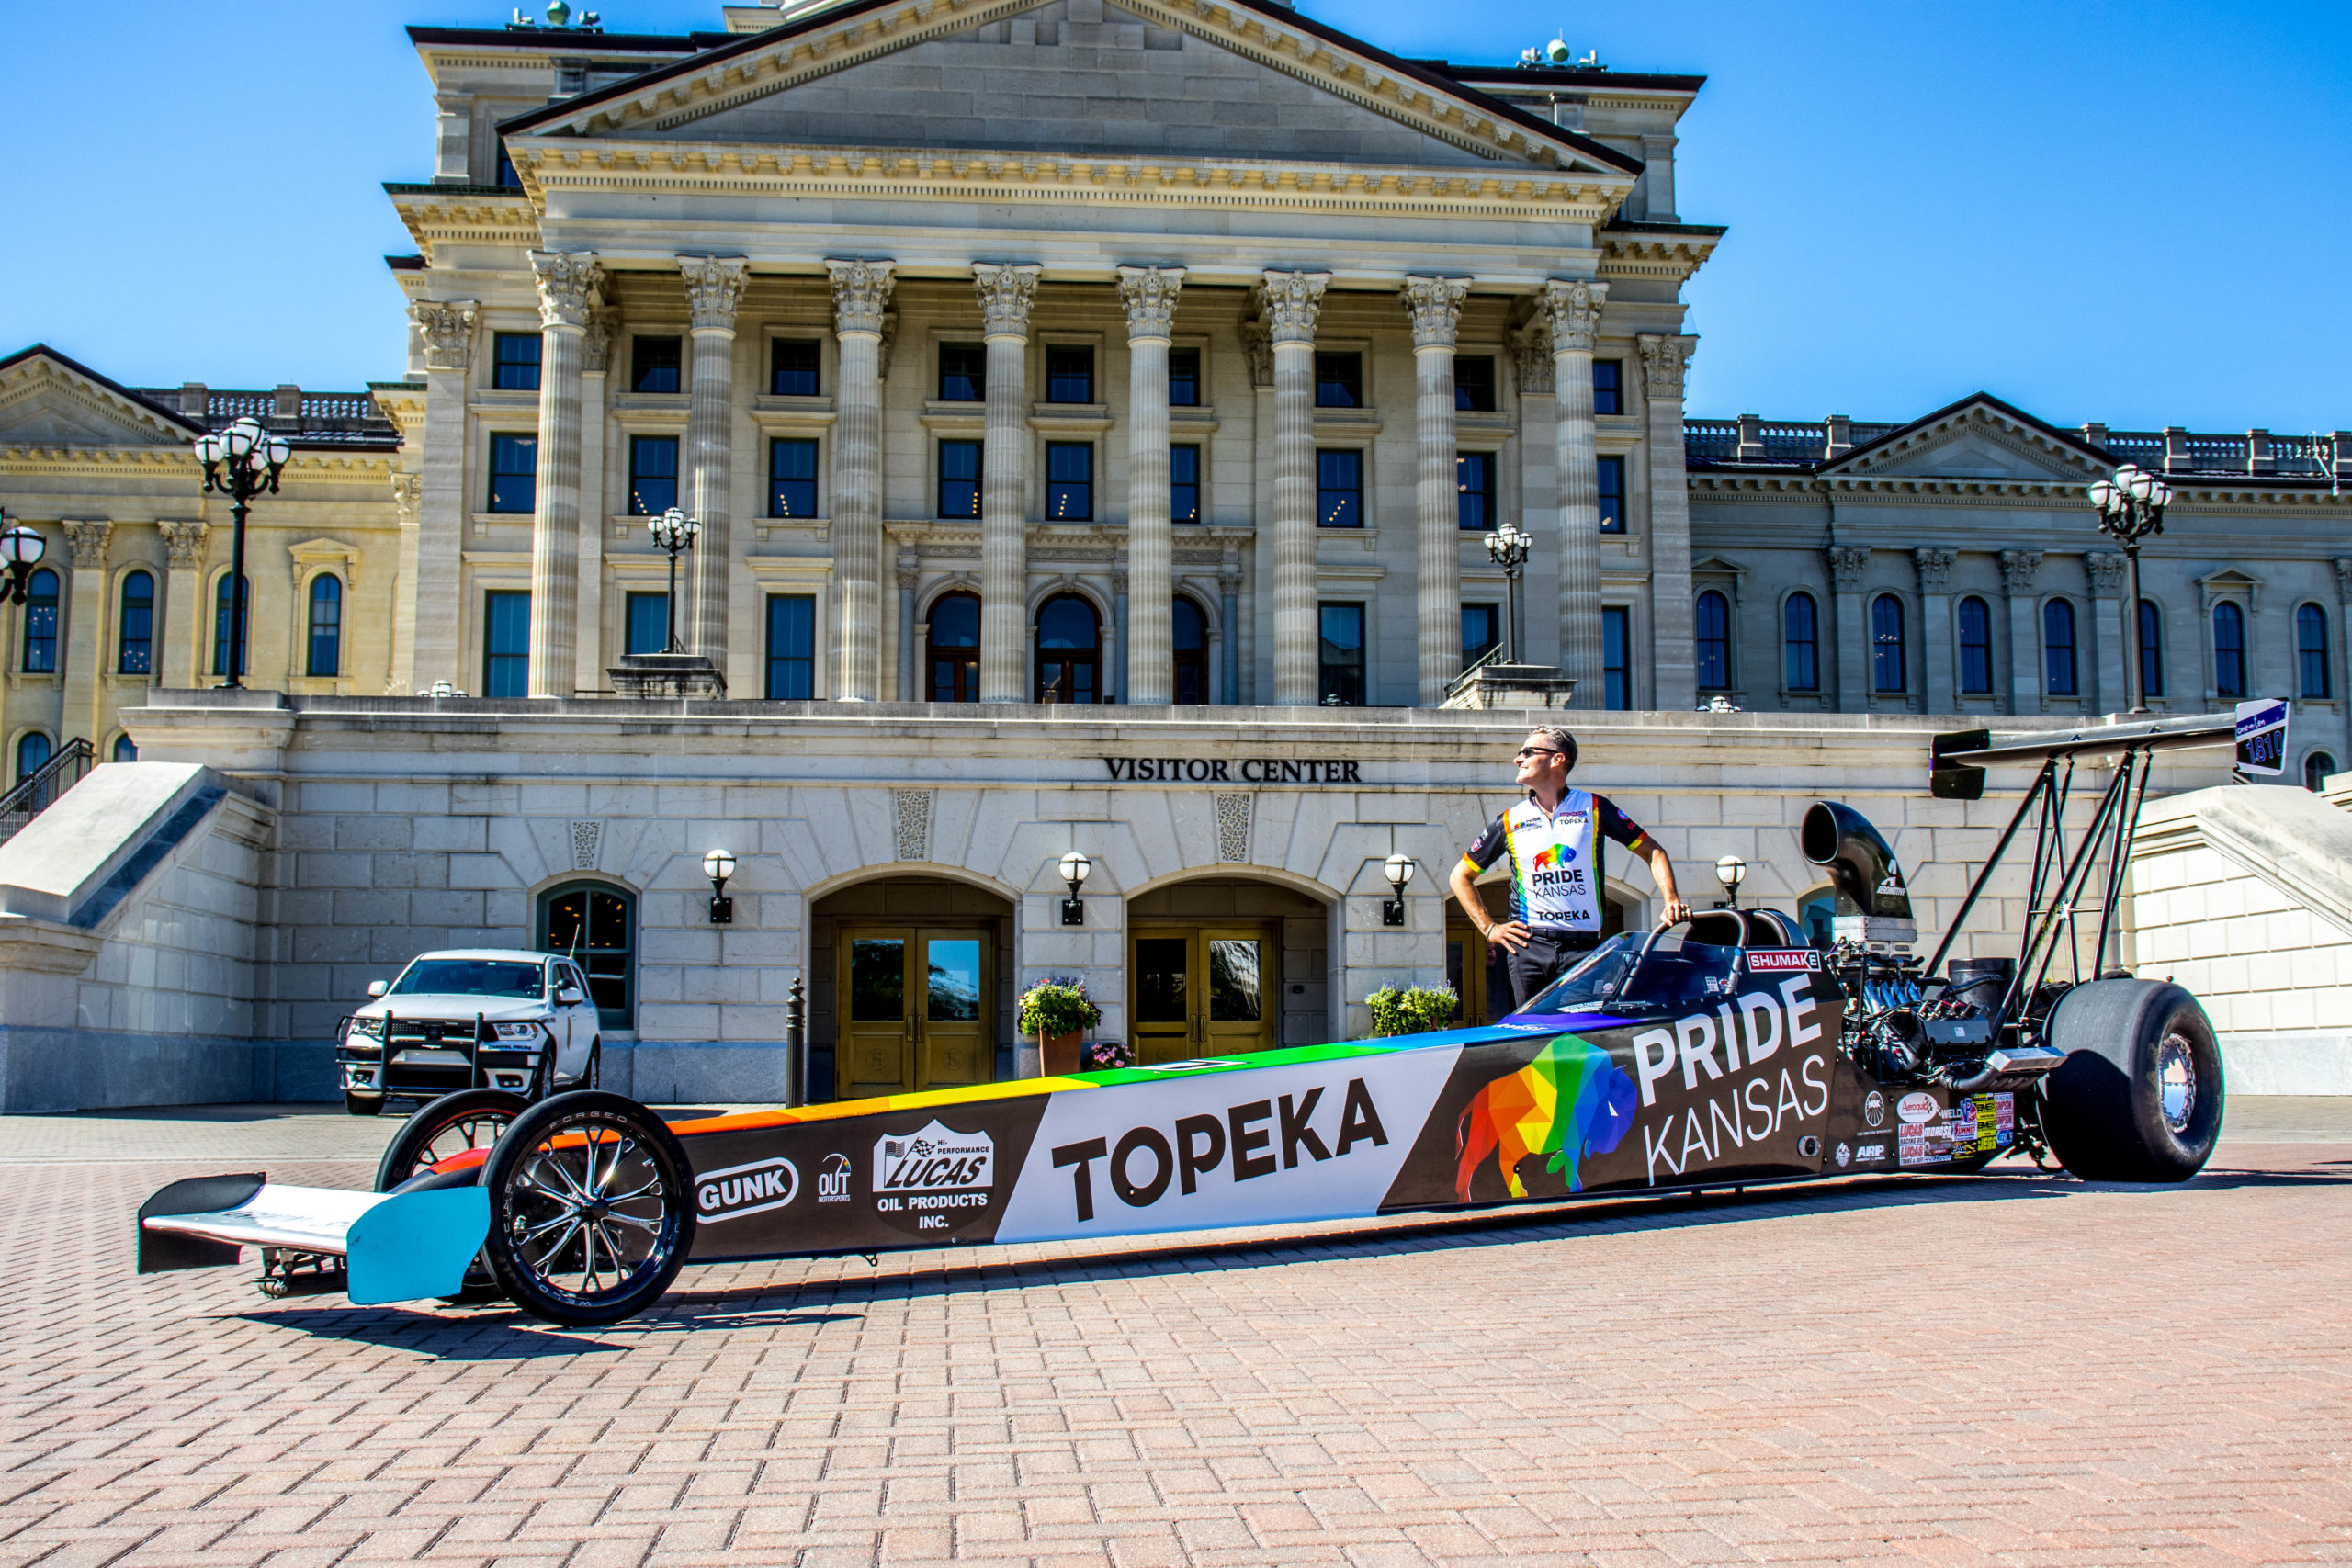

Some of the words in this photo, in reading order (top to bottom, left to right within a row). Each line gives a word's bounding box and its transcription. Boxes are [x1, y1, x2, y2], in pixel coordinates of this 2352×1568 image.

[2245, 730, 2283, 764] 1810
[1104, 759, 1230, 781] VISITOR
[1241, 759, 1362, 783] CENTER
[1532, 869, 1584, 887] PRIDE
[1533, 884, 1587, 899] KANSAS
[1876, 886, 1907, 897] AEROMOTIVE
[1536, 909, 1592, 921] TOPEKA
[1750, 954, 1817, 967] SHUMAKE
[1633, 973, 1822, 1108] PRIDE
[1868, 1099, 1881, 1109] NGK
[549, 1111, 628, 1130] FORGED
[1644, 1055, 1828, 1187] KANSAS
[1941, 1108, 1962, 1119] WELD
[1899, 1124, 1923, 1137] LUCAS
[937, 1146, 989, 1155] PERFORMANCE
[1051, 1077, 1389, 1223] TOPEKA
[1856, 1145, 1885, 1157] ARP
[1900, 1145, 1923, 1157] LUCAS
[885, 1156, 987, 1189] LUCAS
[698, 1168, 787, 1211] GUNK
[818, 1172, 852, 1196] OUT
[818, 1194, 851, 1203] MOTORSPORTS
[877, 1198, 903, 1212] OIL
[908, 1193, 988, 1210] PRODUCTS
[919, 1215, 949, 1229] INC.
